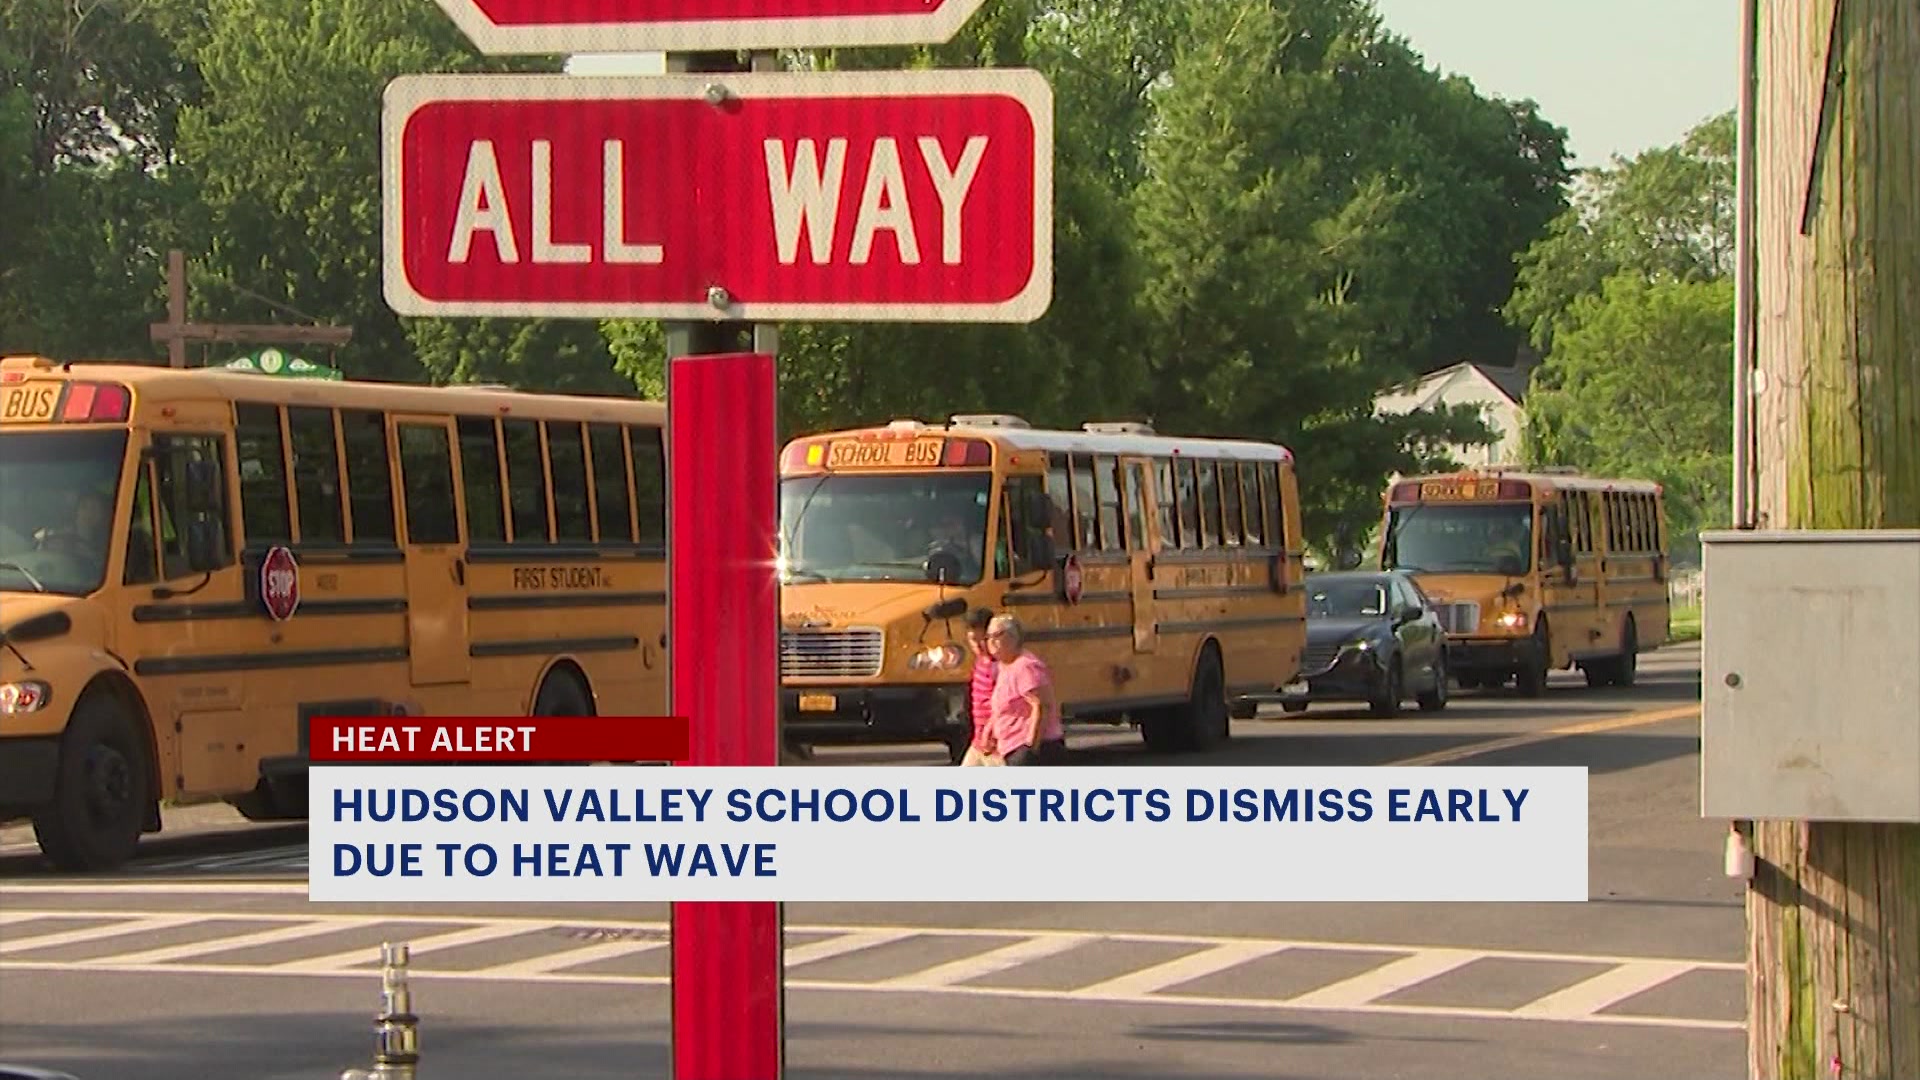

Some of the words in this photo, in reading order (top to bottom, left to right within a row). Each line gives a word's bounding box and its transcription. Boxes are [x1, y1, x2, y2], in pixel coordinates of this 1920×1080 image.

[447, 139, 664, 264] ALL
[763, 135, 988, 265] WAY
[5, 389, 53, 418] BUS
[831, 443, 891, 466] SCHOOL
[905, 443, 939, 462] BUS
[514, 567, 545, 588] FIRST
[550, 567, 601, 588] STUDENT
